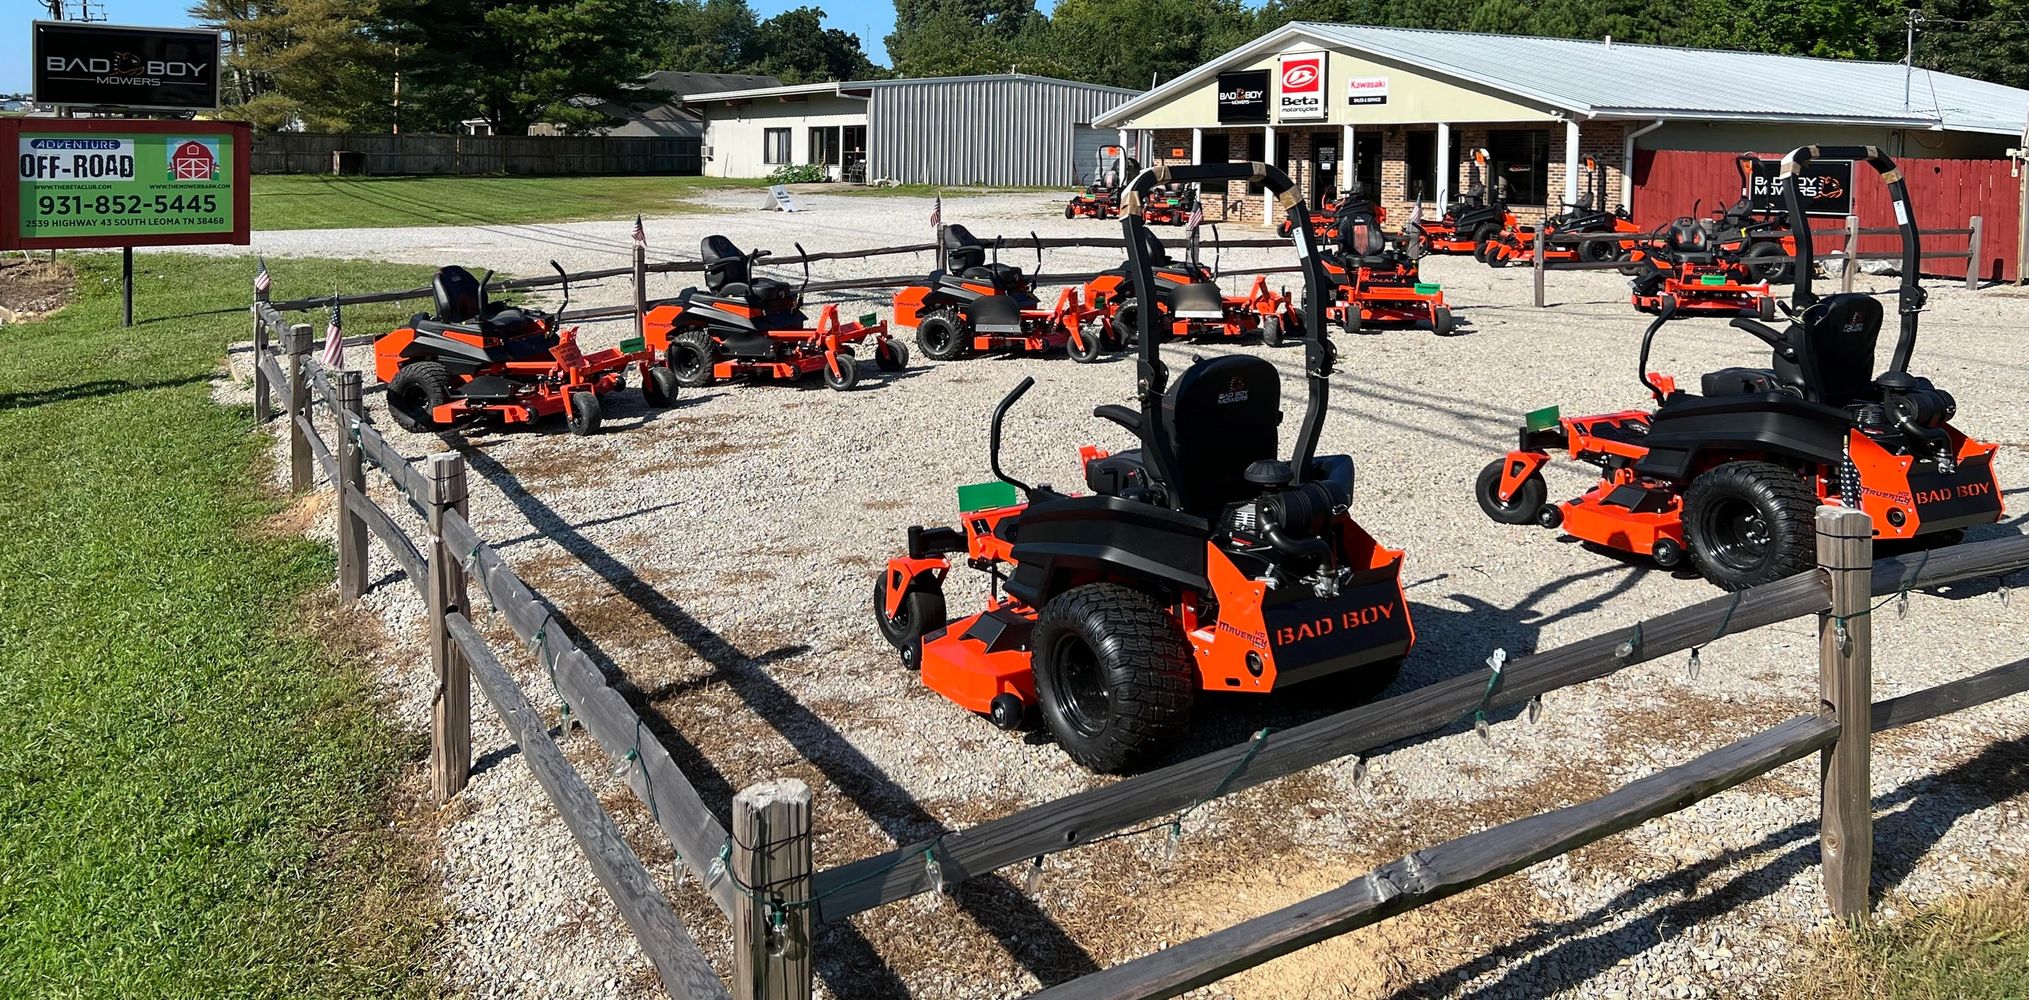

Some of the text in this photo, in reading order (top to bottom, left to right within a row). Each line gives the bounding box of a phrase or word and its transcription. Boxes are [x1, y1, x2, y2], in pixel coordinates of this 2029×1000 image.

[47, 56, 207, 77] BAD BOY
[96, 76, 161, 87] MOWERS
[1350, 80, 1386, 89] Kawasaki
[1219, 90, 1263, 100] BAD BOY
[1281, 96, 1319, 106] Beta
[36, 140, 117, 150] ADVENTURE
[20, 153, 134, 178] OFF-ROAD
[1754, 185, 1817, 197] MOWRS
[39, 194, 217, 215] 931-852-5445
[25, 217, 225, 228] 2539 HIGHWAY 43 SOUTH LEOMA TN 38468
[1916, 482, 1990, 505] BAD BOY
[1277, 602, 1394, 646] BAD BOY
